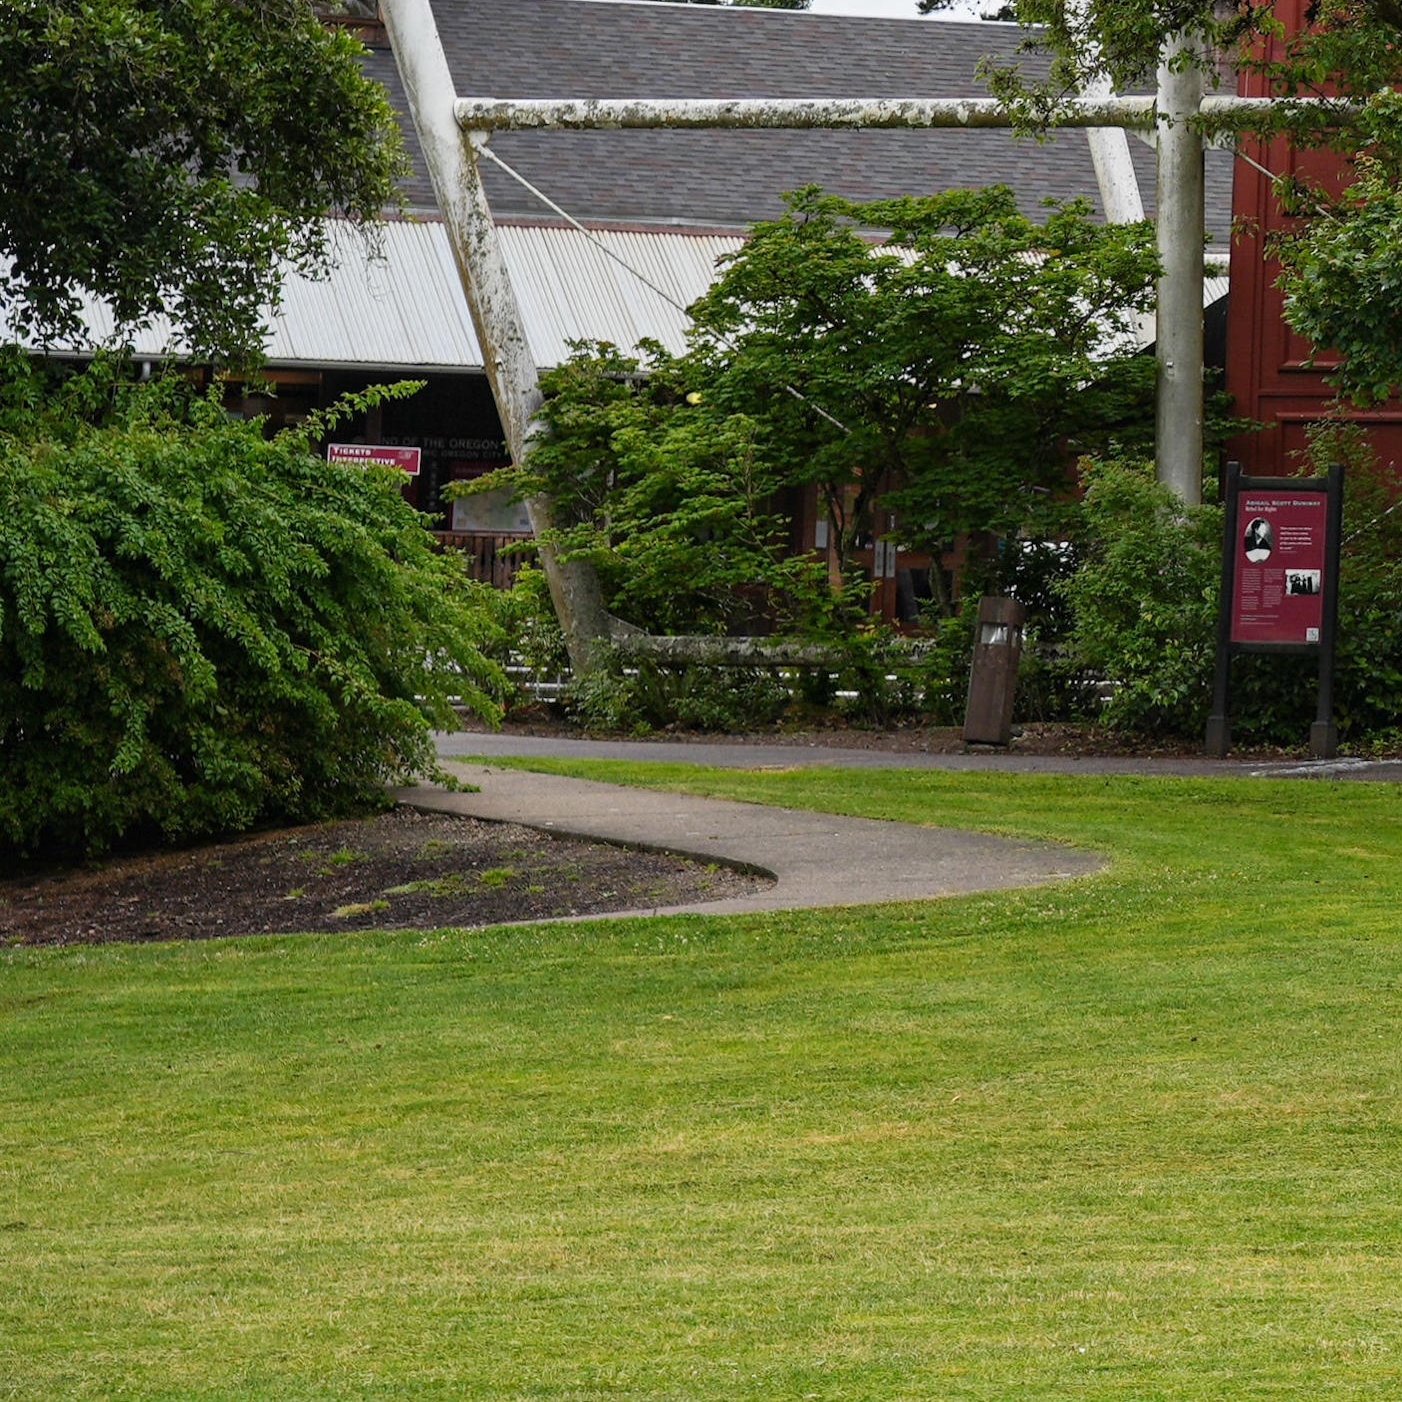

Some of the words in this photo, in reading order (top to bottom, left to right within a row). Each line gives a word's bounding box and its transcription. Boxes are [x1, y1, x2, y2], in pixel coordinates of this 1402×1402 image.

[423, 437, 446, 448] THE
[449, 438, 498, 450] OREGON
[333, 447, 372, 456] TICKETS
